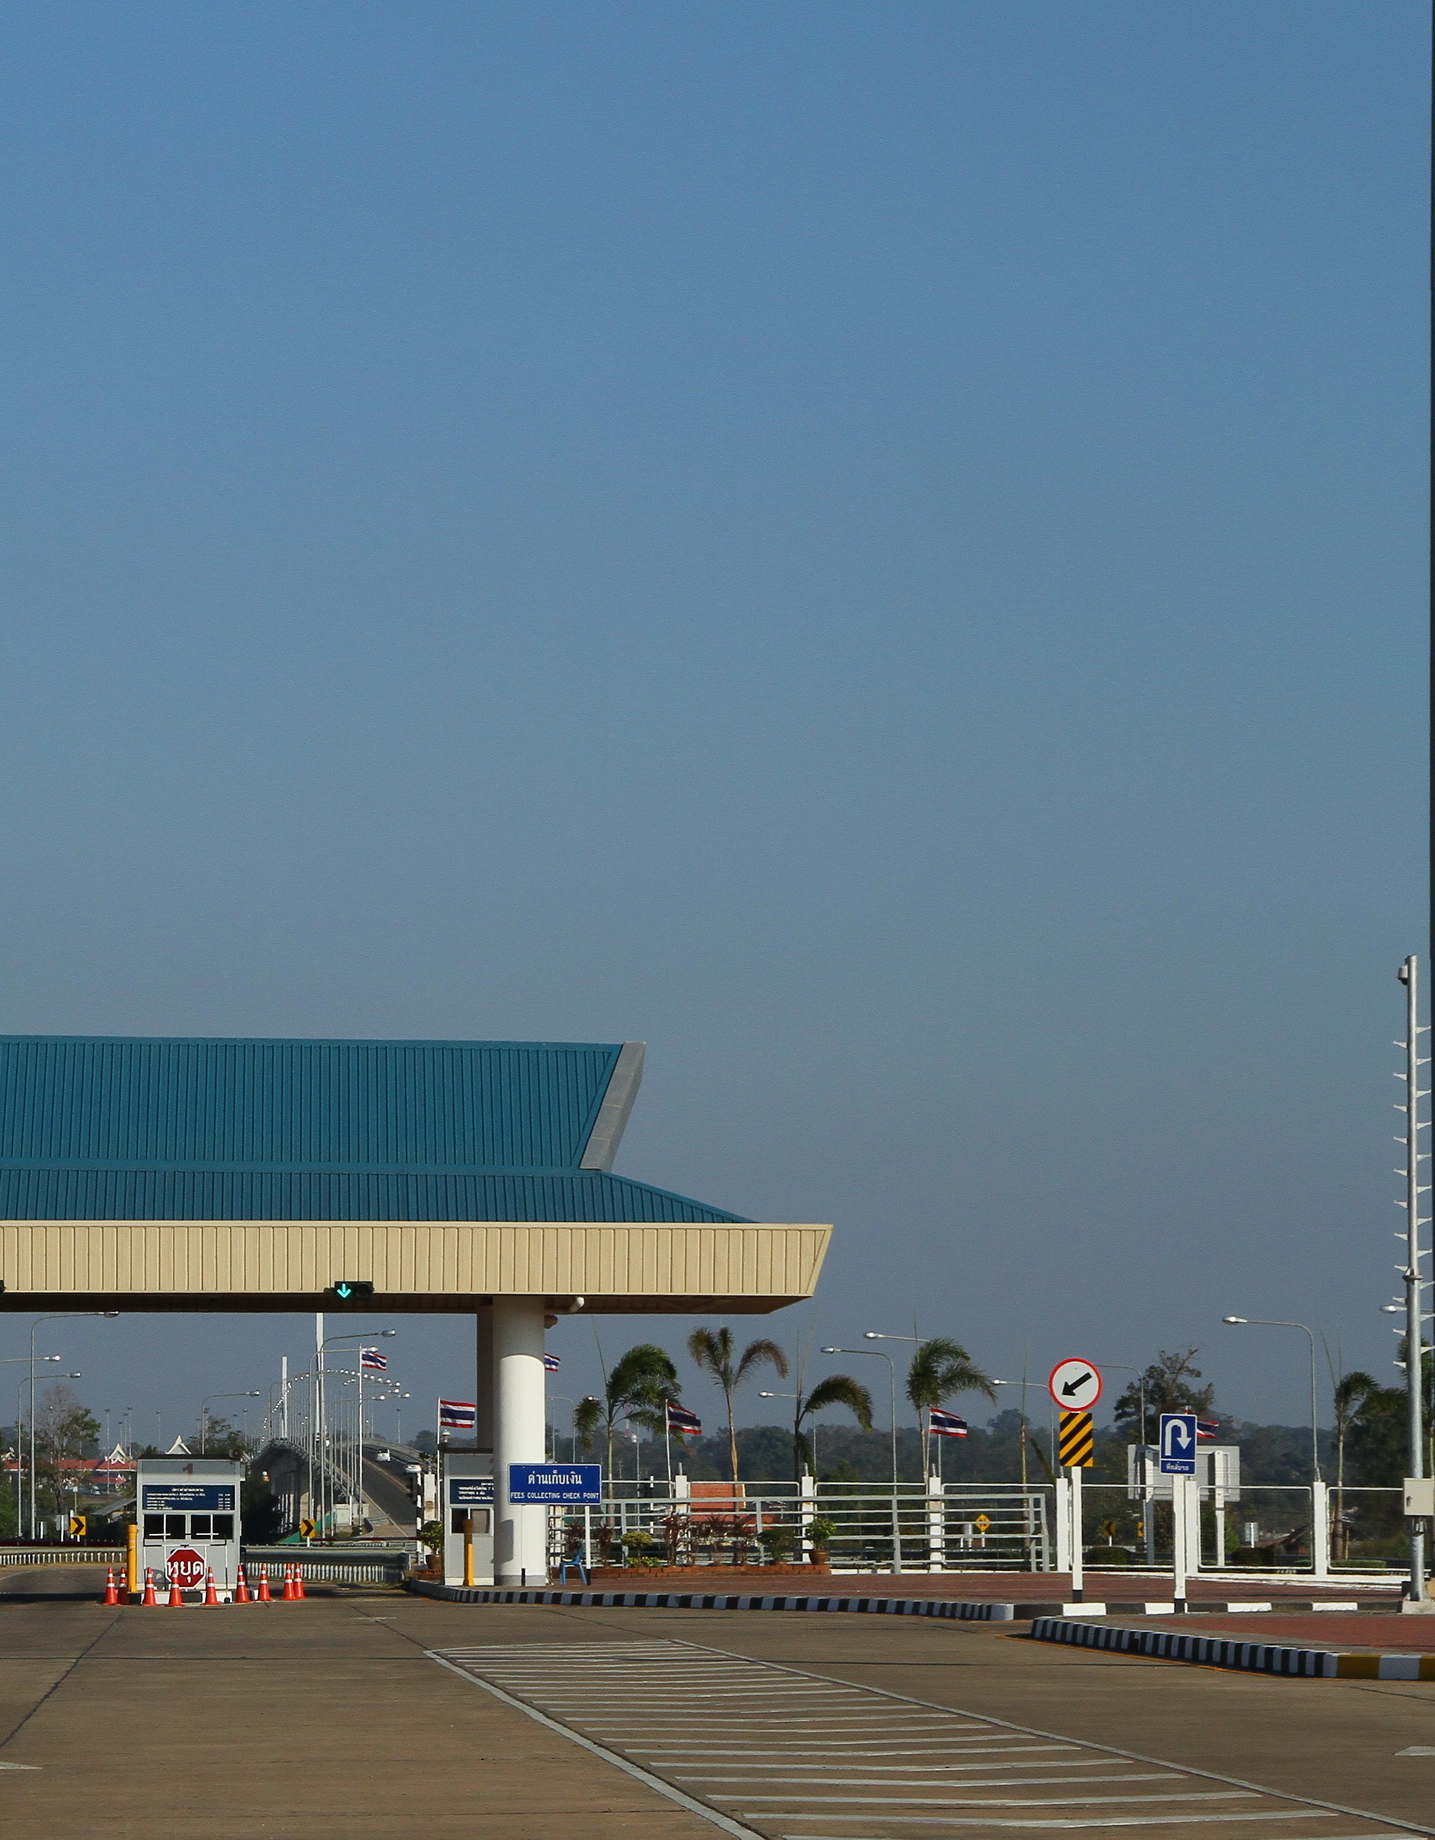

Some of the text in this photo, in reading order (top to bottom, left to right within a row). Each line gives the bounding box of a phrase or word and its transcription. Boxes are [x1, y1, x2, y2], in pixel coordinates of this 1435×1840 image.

[528, 1469, 583, 1485] ด่านเก็บเงิน
[167, 1561, 204, 1584] หยุด
